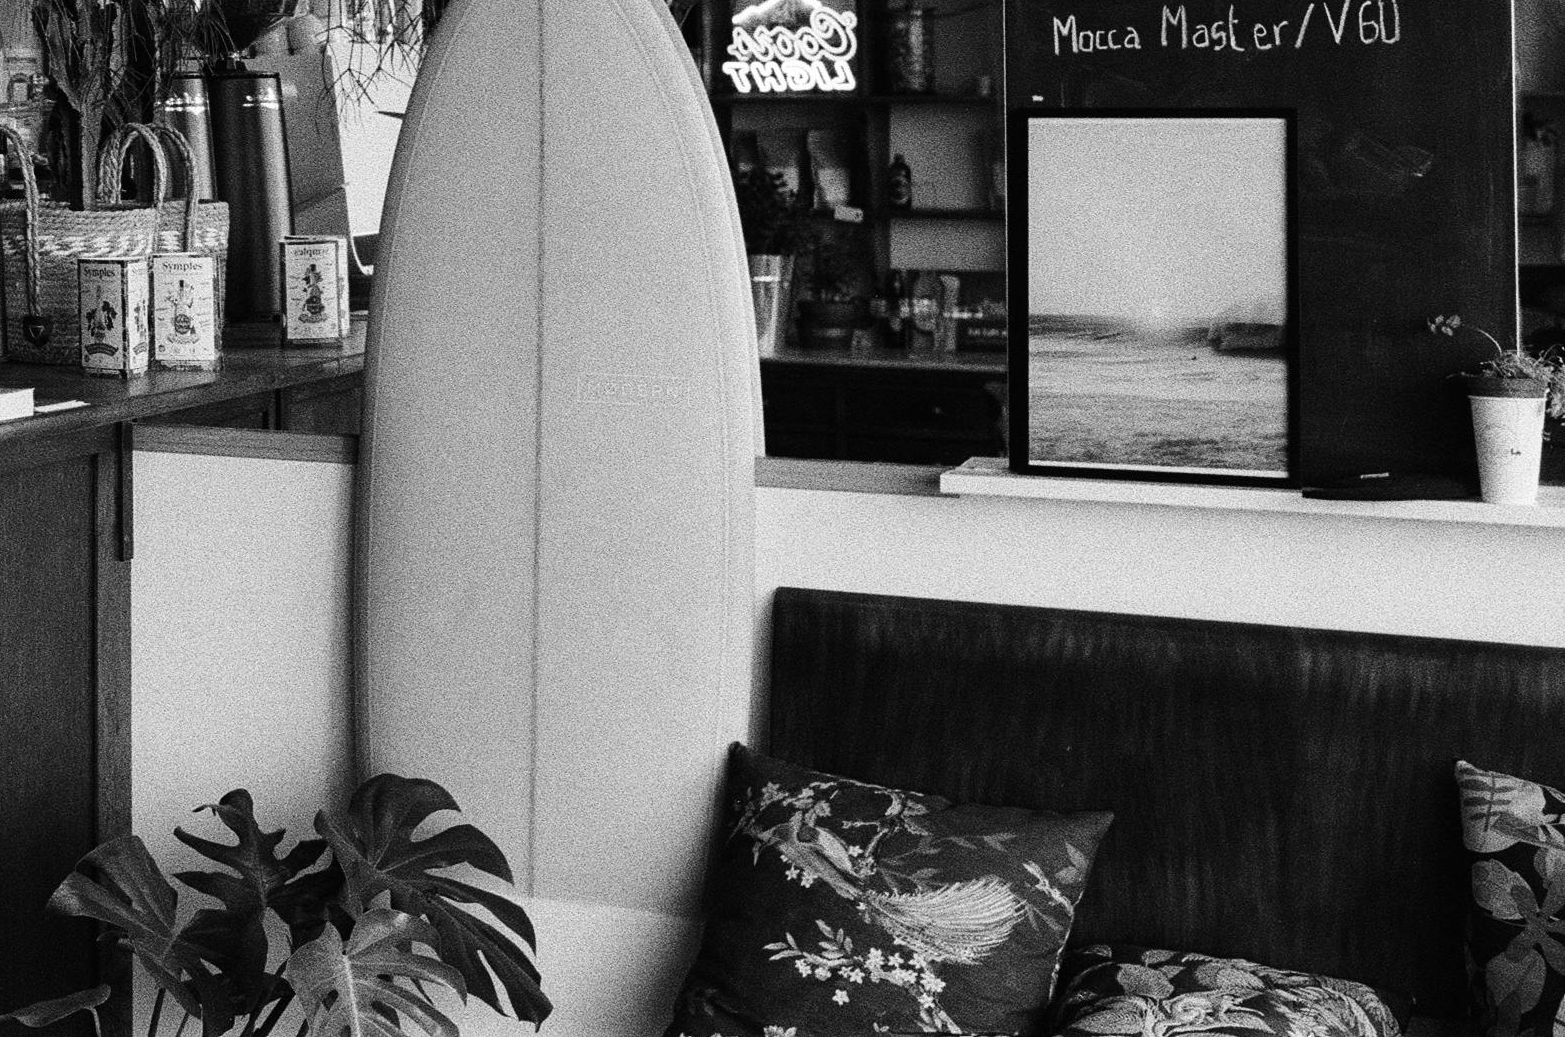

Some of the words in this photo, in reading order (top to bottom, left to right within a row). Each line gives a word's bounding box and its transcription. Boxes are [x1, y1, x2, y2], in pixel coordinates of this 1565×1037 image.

[1052, 14, 1142, 55] Mocca
[83, 266, 116, 280] Symples
[162, 261, 203, 273] Symples
